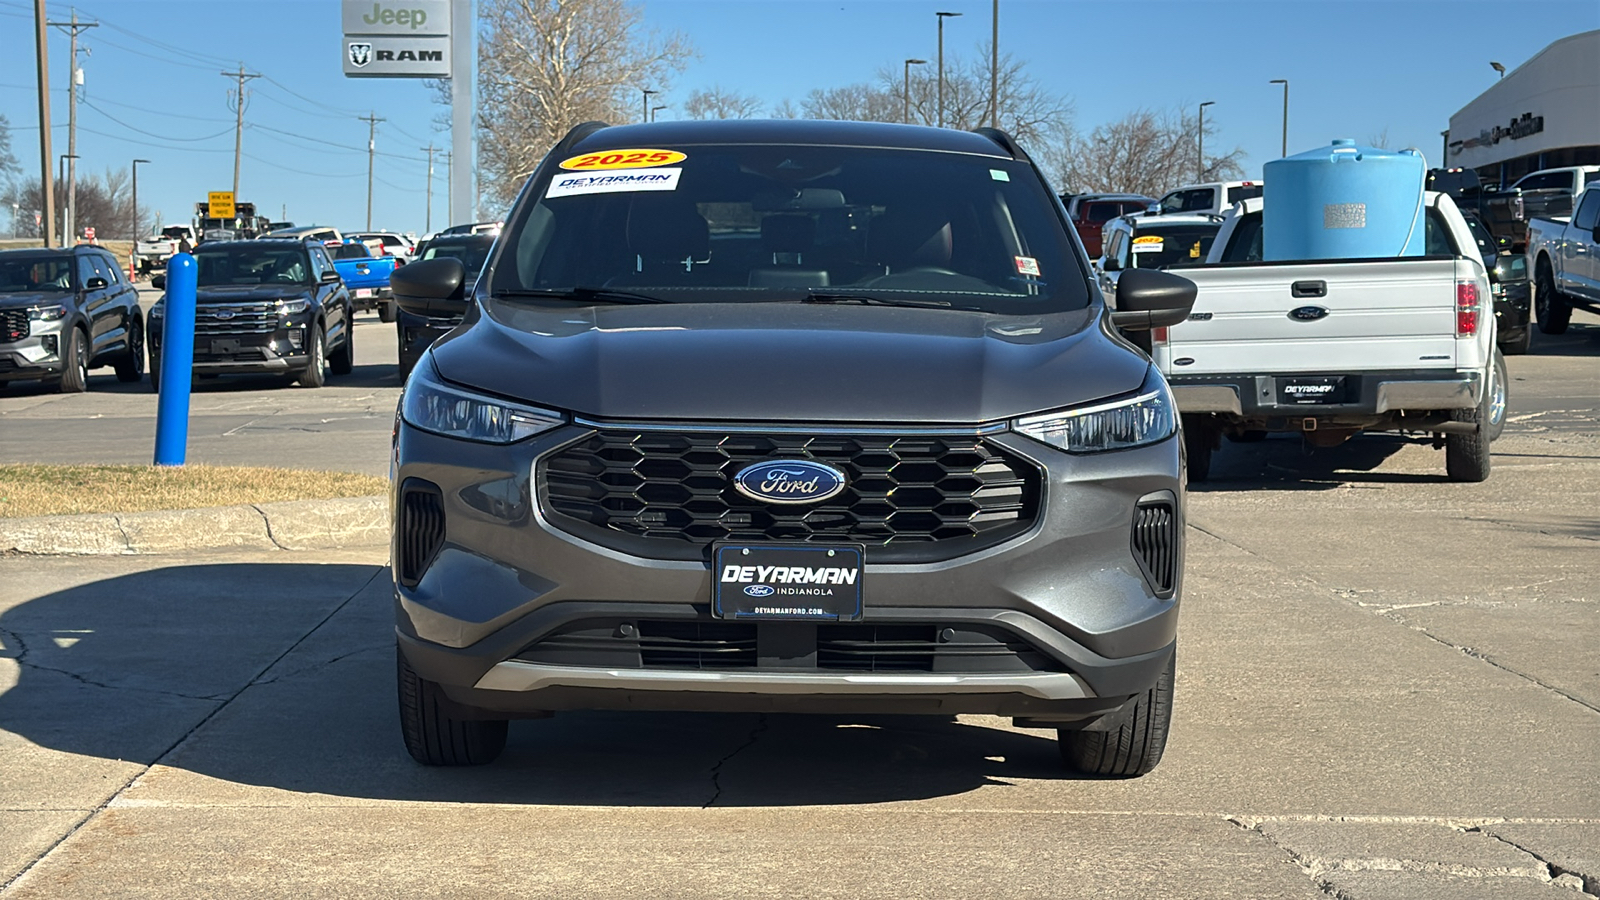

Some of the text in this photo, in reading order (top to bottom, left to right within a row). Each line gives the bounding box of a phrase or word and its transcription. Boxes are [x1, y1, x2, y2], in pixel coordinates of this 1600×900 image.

[363, 3, 427, 30] Jeep
[376, 50, 442, 61] RAM
[573, 152, 672, 168] 2025
[558, 174, 672, 187] DEYARMAN
[1284, 385, 1336, 393] DEYARMAN
[760, 468, 820, 494] Ford
[721, 565, 858, 585] DEYARMAN
[749, 585, 834, 596] Ford INDIANOLA
[754, 607, 823, 615] DEYARMANFORD.COM
